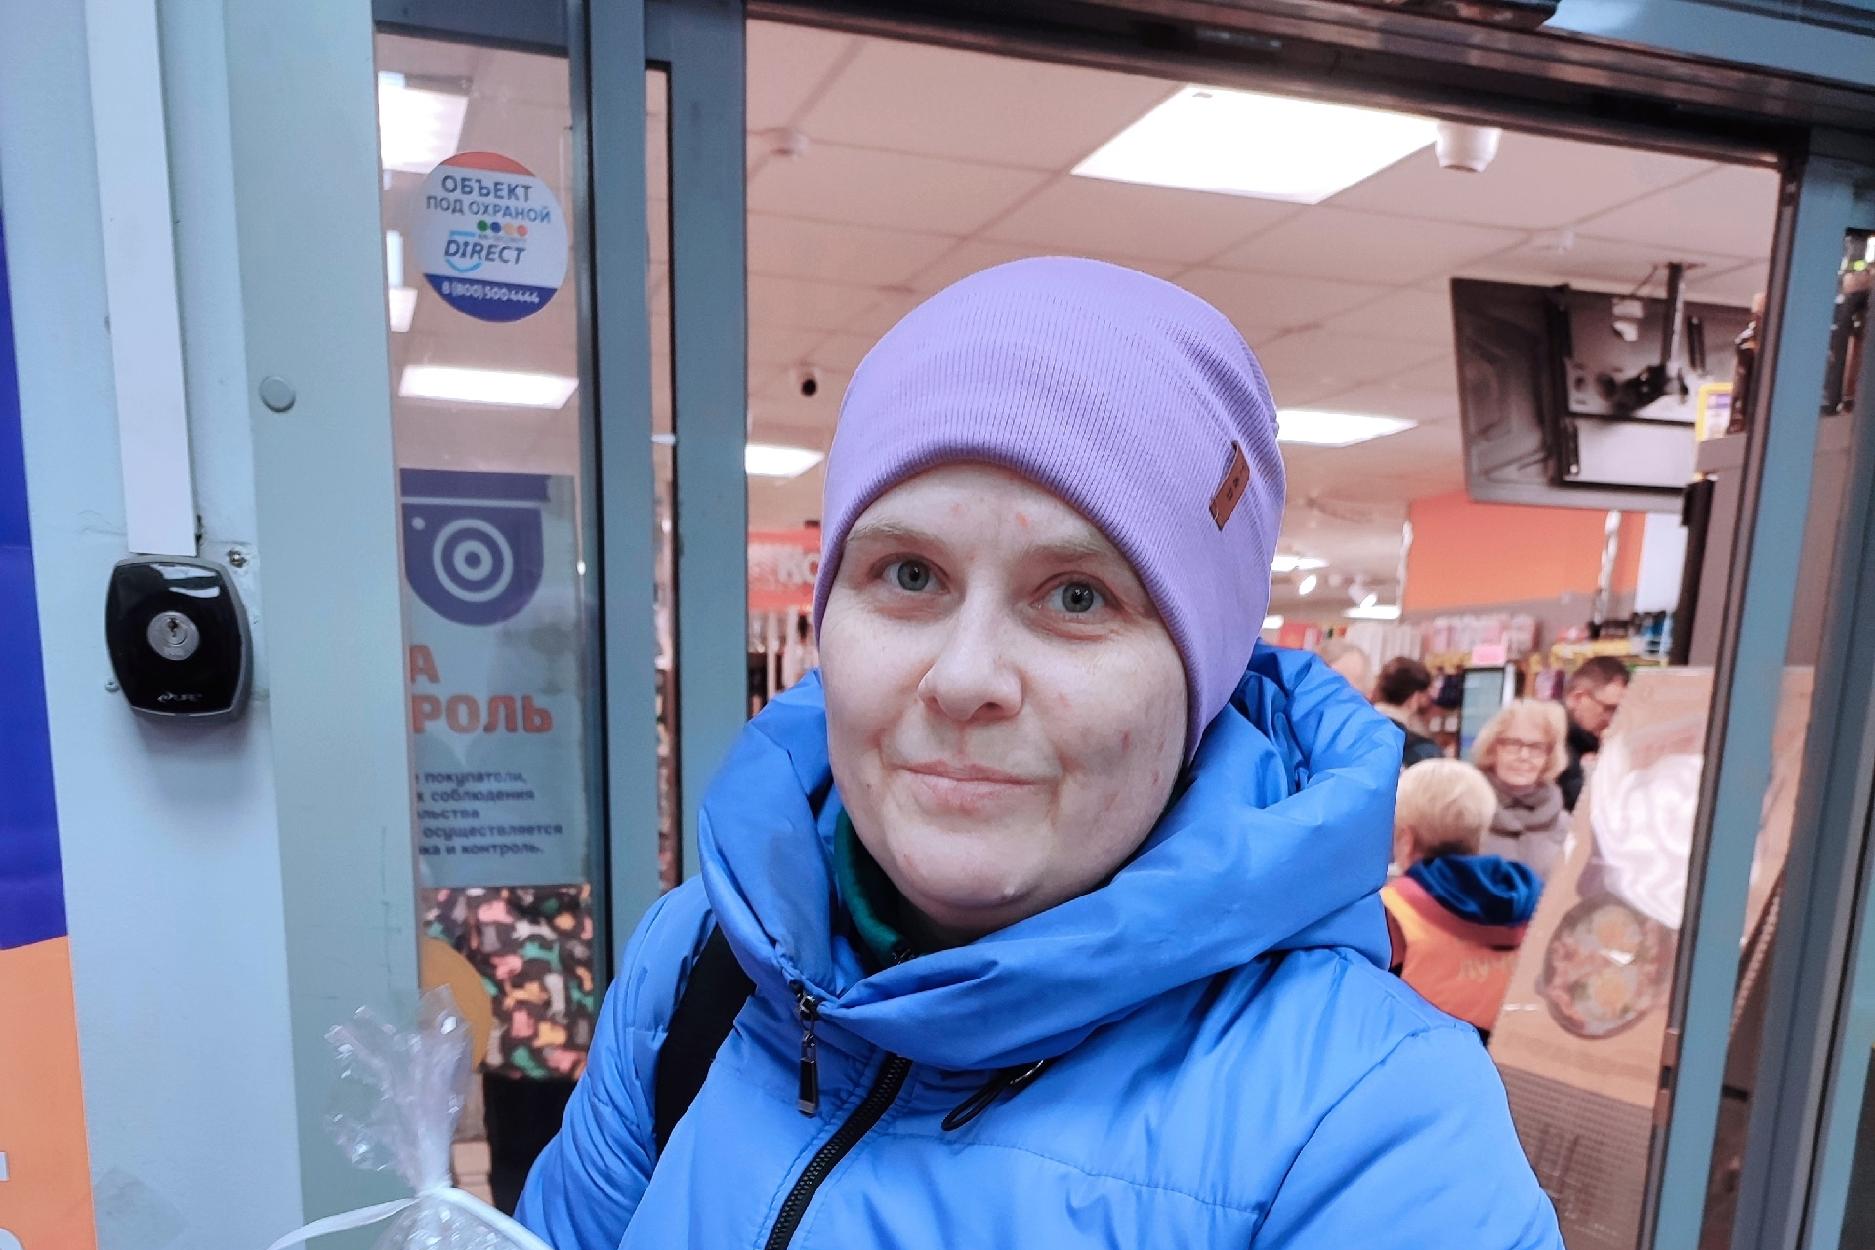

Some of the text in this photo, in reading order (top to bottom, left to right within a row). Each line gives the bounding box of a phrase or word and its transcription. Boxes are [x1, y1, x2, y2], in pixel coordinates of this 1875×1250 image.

[441, 175, 533, 203] ОБЪЕКТ
[426, 196, 552, 224] ПОД ОХРАНОЙ
[444, 239, 527, 265] DIRECT
[412, 693, 554, 734] РОЛЬ
[430, 788, 536, 803] соблюдения
[422, 823, 563, 841] осуществляется
